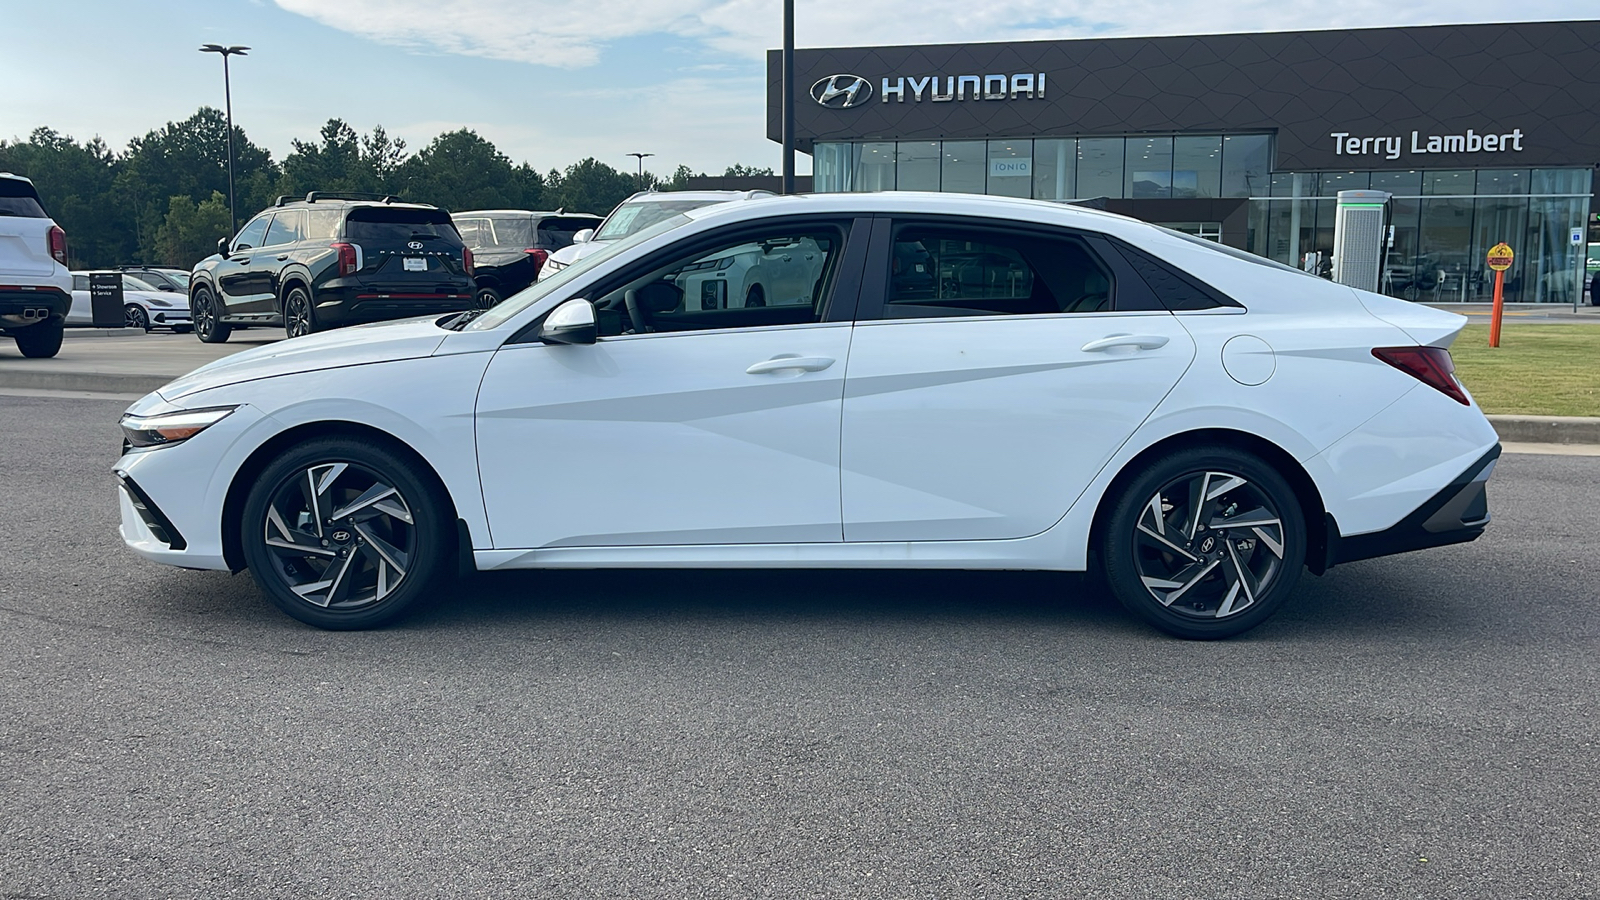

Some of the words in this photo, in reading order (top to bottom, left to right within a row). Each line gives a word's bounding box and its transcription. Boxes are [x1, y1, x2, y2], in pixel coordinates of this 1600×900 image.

[881, 72, 1047, 103] HYUNDAI
[1330, 131, 1401, 160] Terry
[1410, 128, 1524, 154] Lambert
